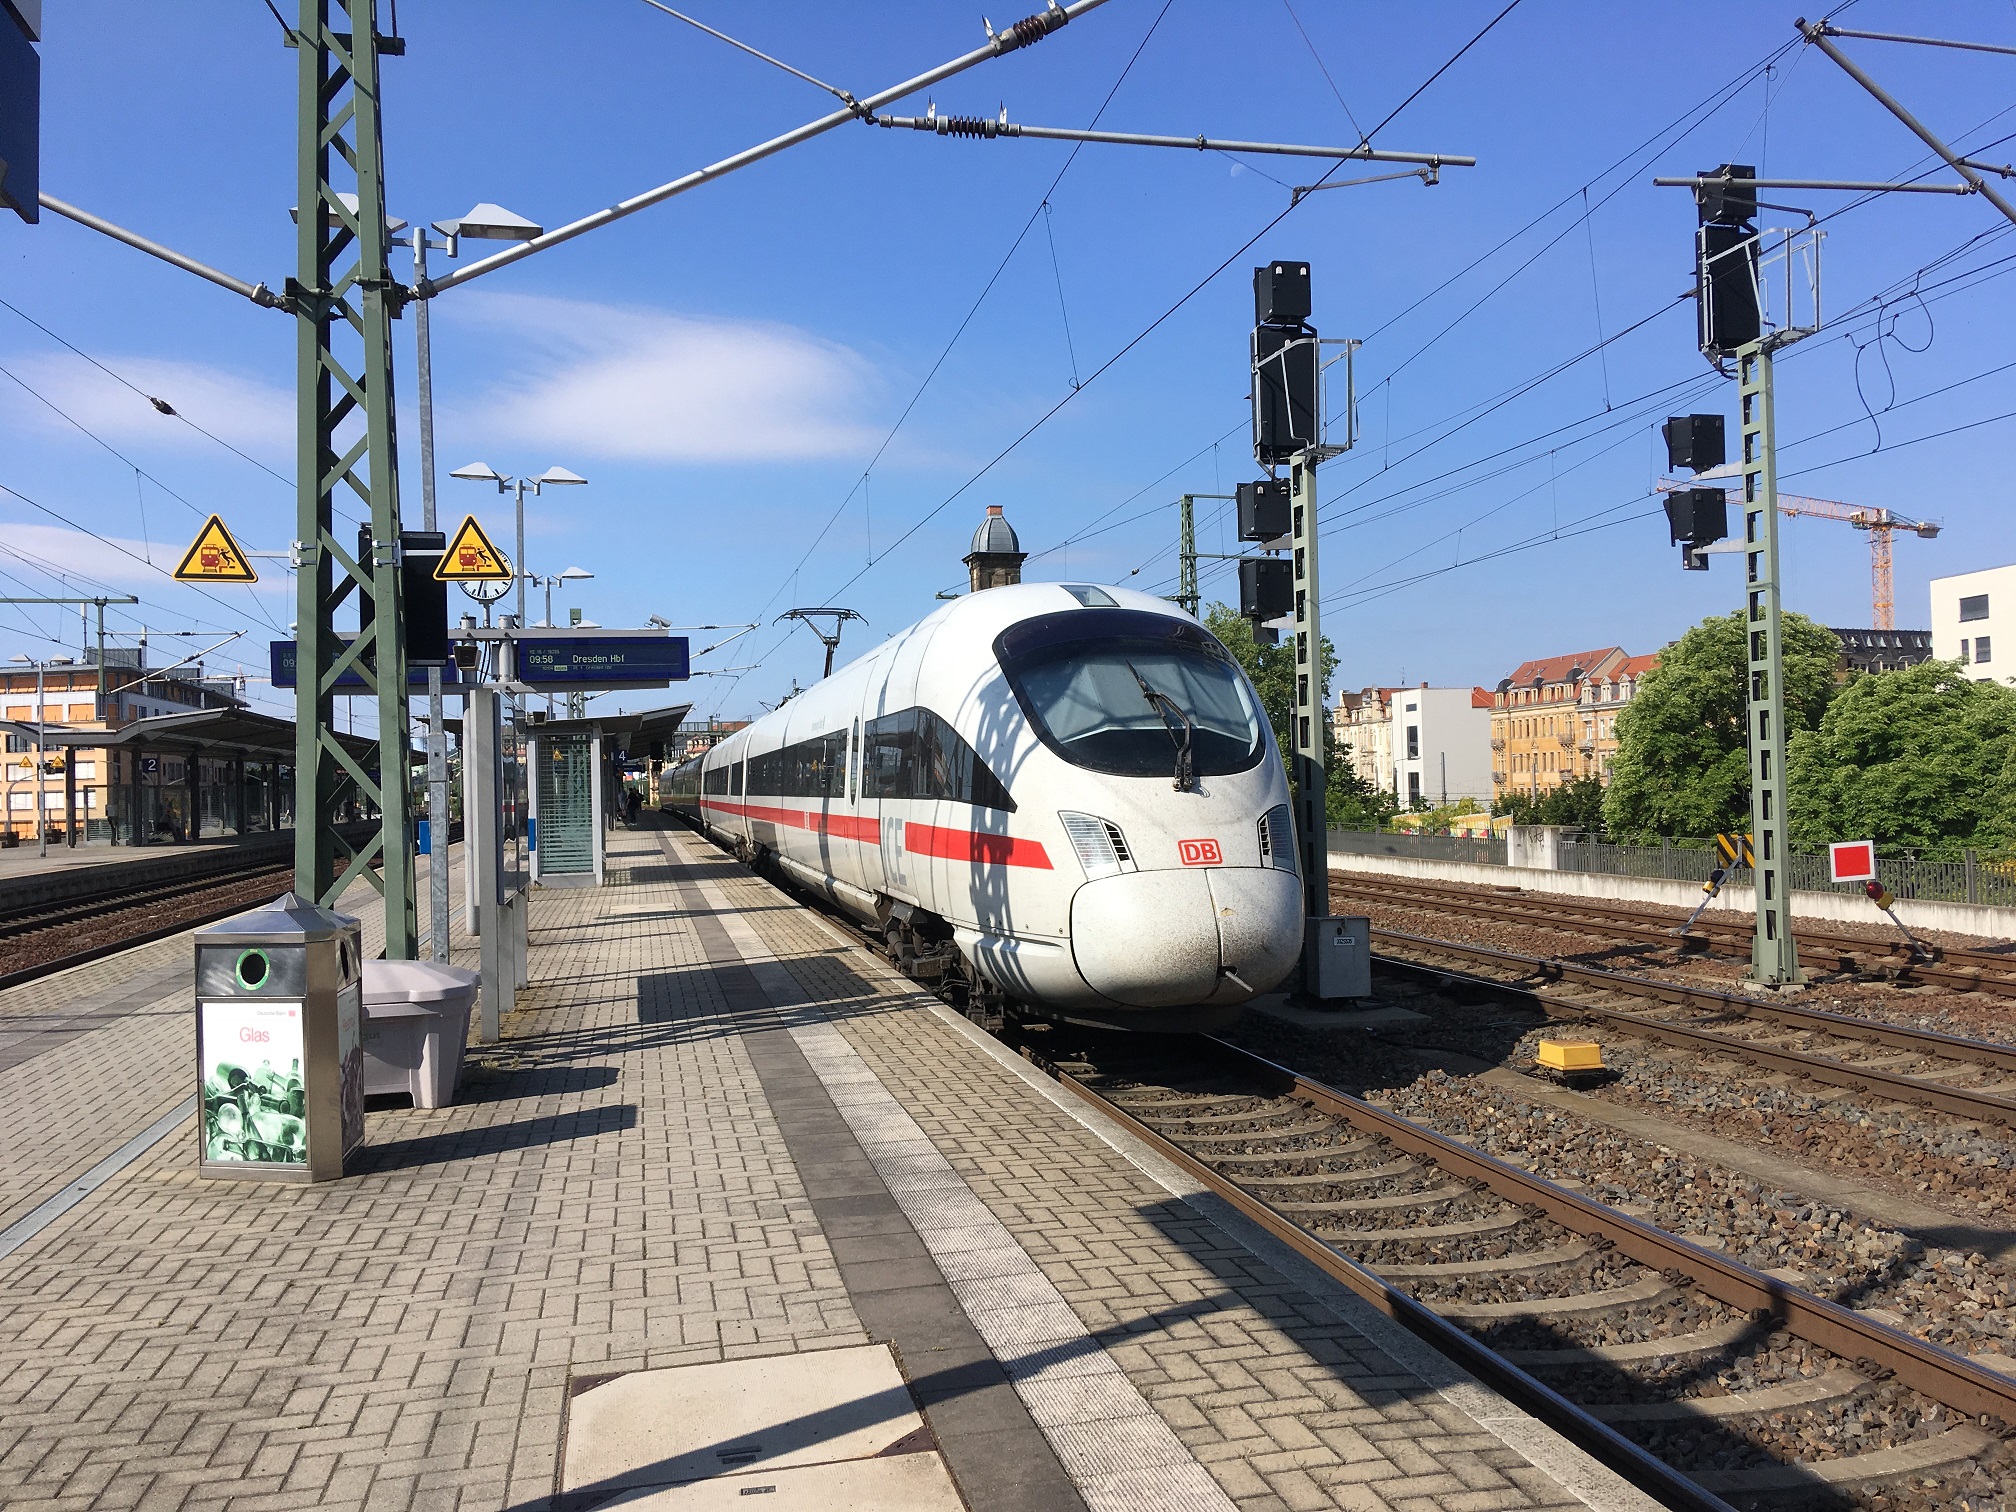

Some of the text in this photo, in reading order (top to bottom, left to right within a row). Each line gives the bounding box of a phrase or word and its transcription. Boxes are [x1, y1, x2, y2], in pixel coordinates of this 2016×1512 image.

[529, 654, 625, 664] 09:58 Dresden Hbf
[618, 750, 627, 761] 4
[148, 759, 156, 771] 2
[882, 816, 907, 886] ICE
[1183, 842, 1217, 861] DB
[239, 1026, 270, 1043] Glas
